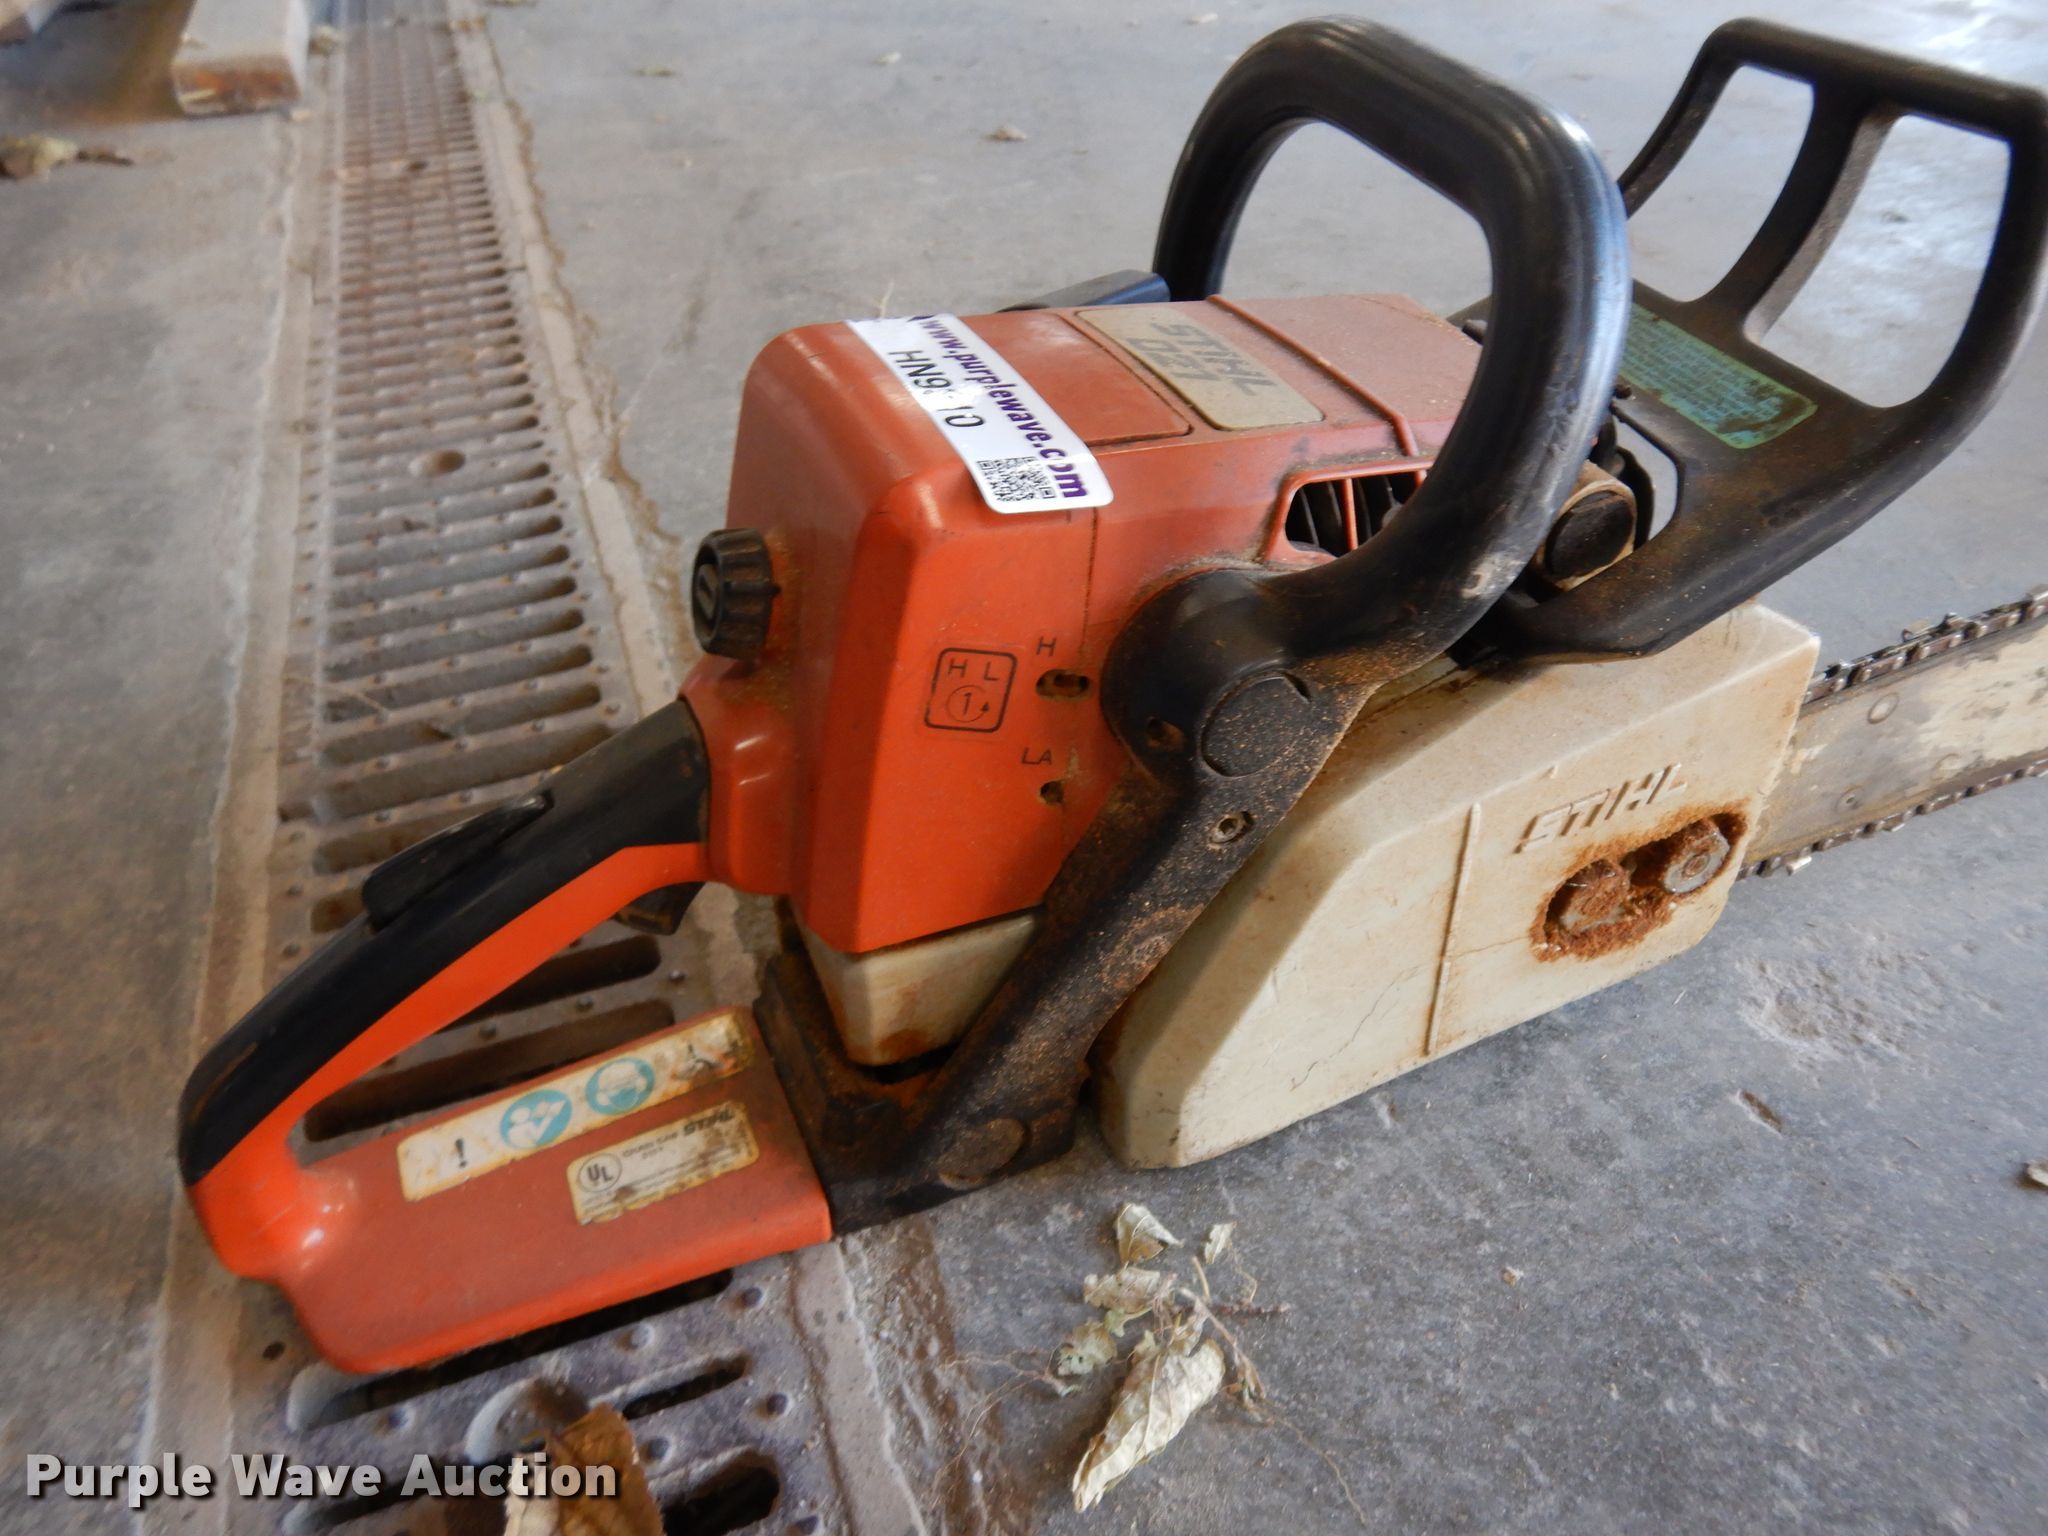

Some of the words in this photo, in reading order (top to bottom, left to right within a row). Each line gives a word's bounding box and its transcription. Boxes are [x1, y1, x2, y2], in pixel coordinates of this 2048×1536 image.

[1153, 323, 1279, 396] STIHL
[888, 349, 986, 428] HN910
[1036, 636, 1057, 657] H
[948, 657, 968, 678] H
[983, 661, 1000, 682] L
[963, 692, 972, 716] 1
[1021, 747, 1053, 766] LA
[586, 1163, 615, 1184] UL
